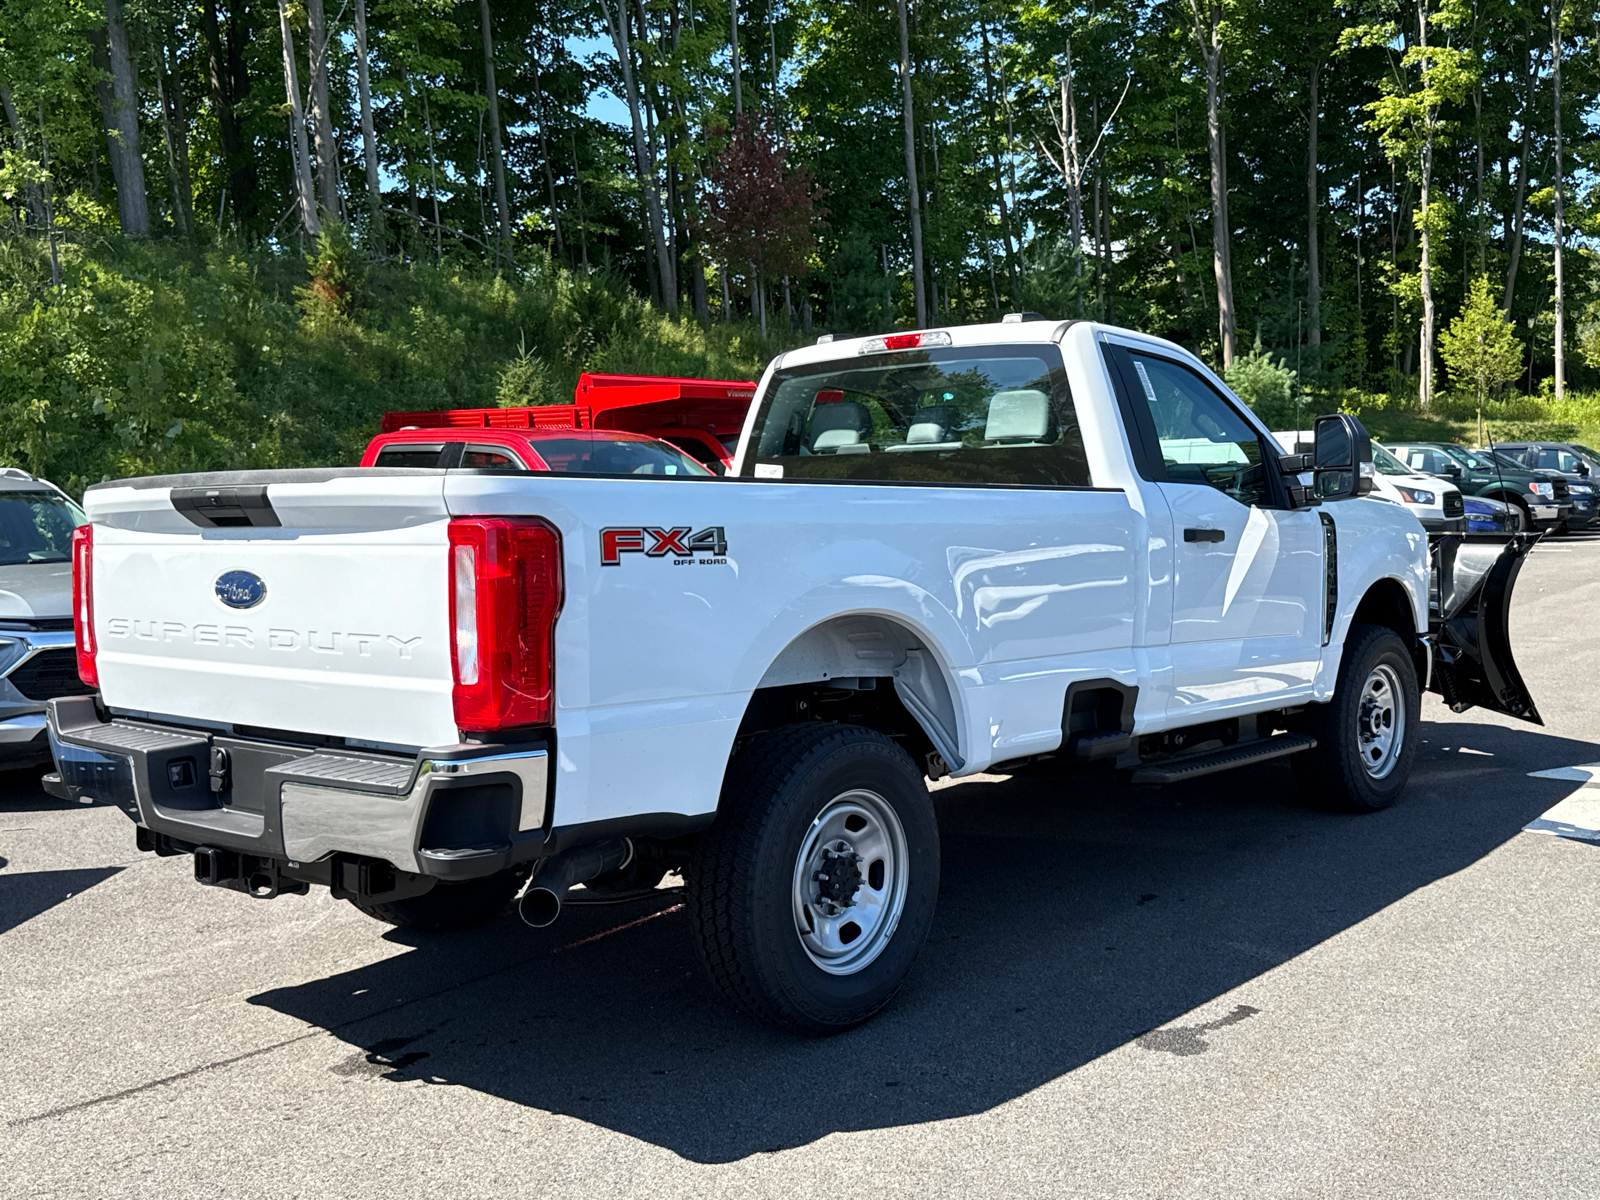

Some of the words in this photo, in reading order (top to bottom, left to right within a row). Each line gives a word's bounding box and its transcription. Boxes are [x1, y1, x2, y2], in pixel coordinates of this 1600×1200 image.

[599, 526, 728, 567] FX4
[673, 558, 696, 566] OFF
[698, 557, 728, 565] ROAD
[108, 618, 254, 649] SUPER
[269, 628, 423, 660] DUTY
